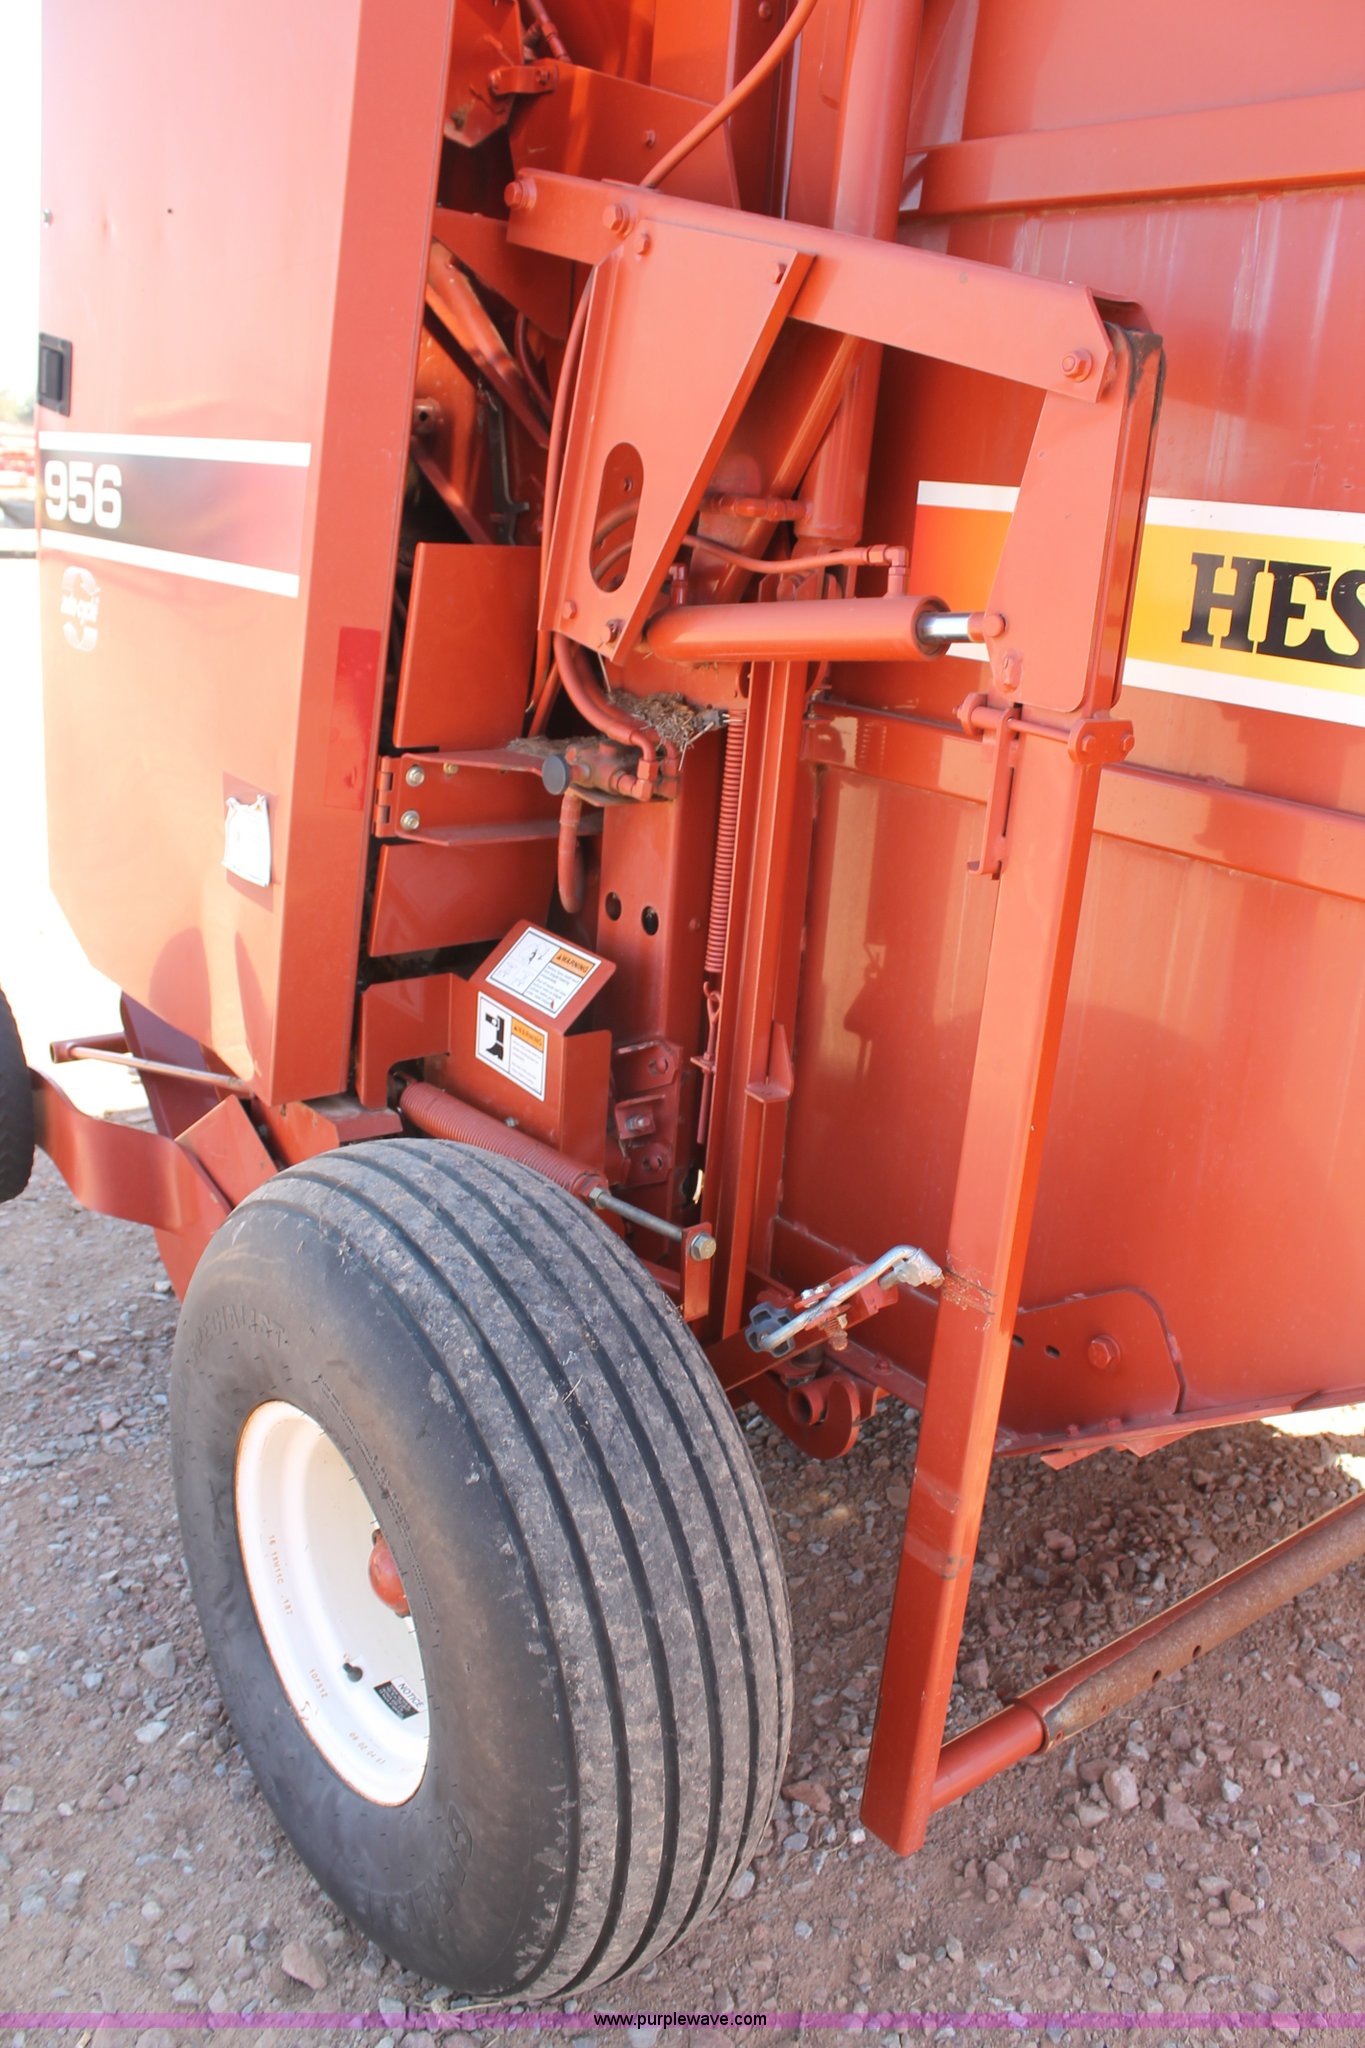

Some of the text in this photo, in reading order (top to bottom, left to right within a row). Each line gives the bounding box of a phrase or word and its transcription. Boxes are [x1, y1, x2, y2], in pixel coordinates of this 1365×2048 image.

[44, 460, 122, 529] 956
[561, 955, 589, 974] WARNING
[398, 1682, 424, 1708] NOTICE
